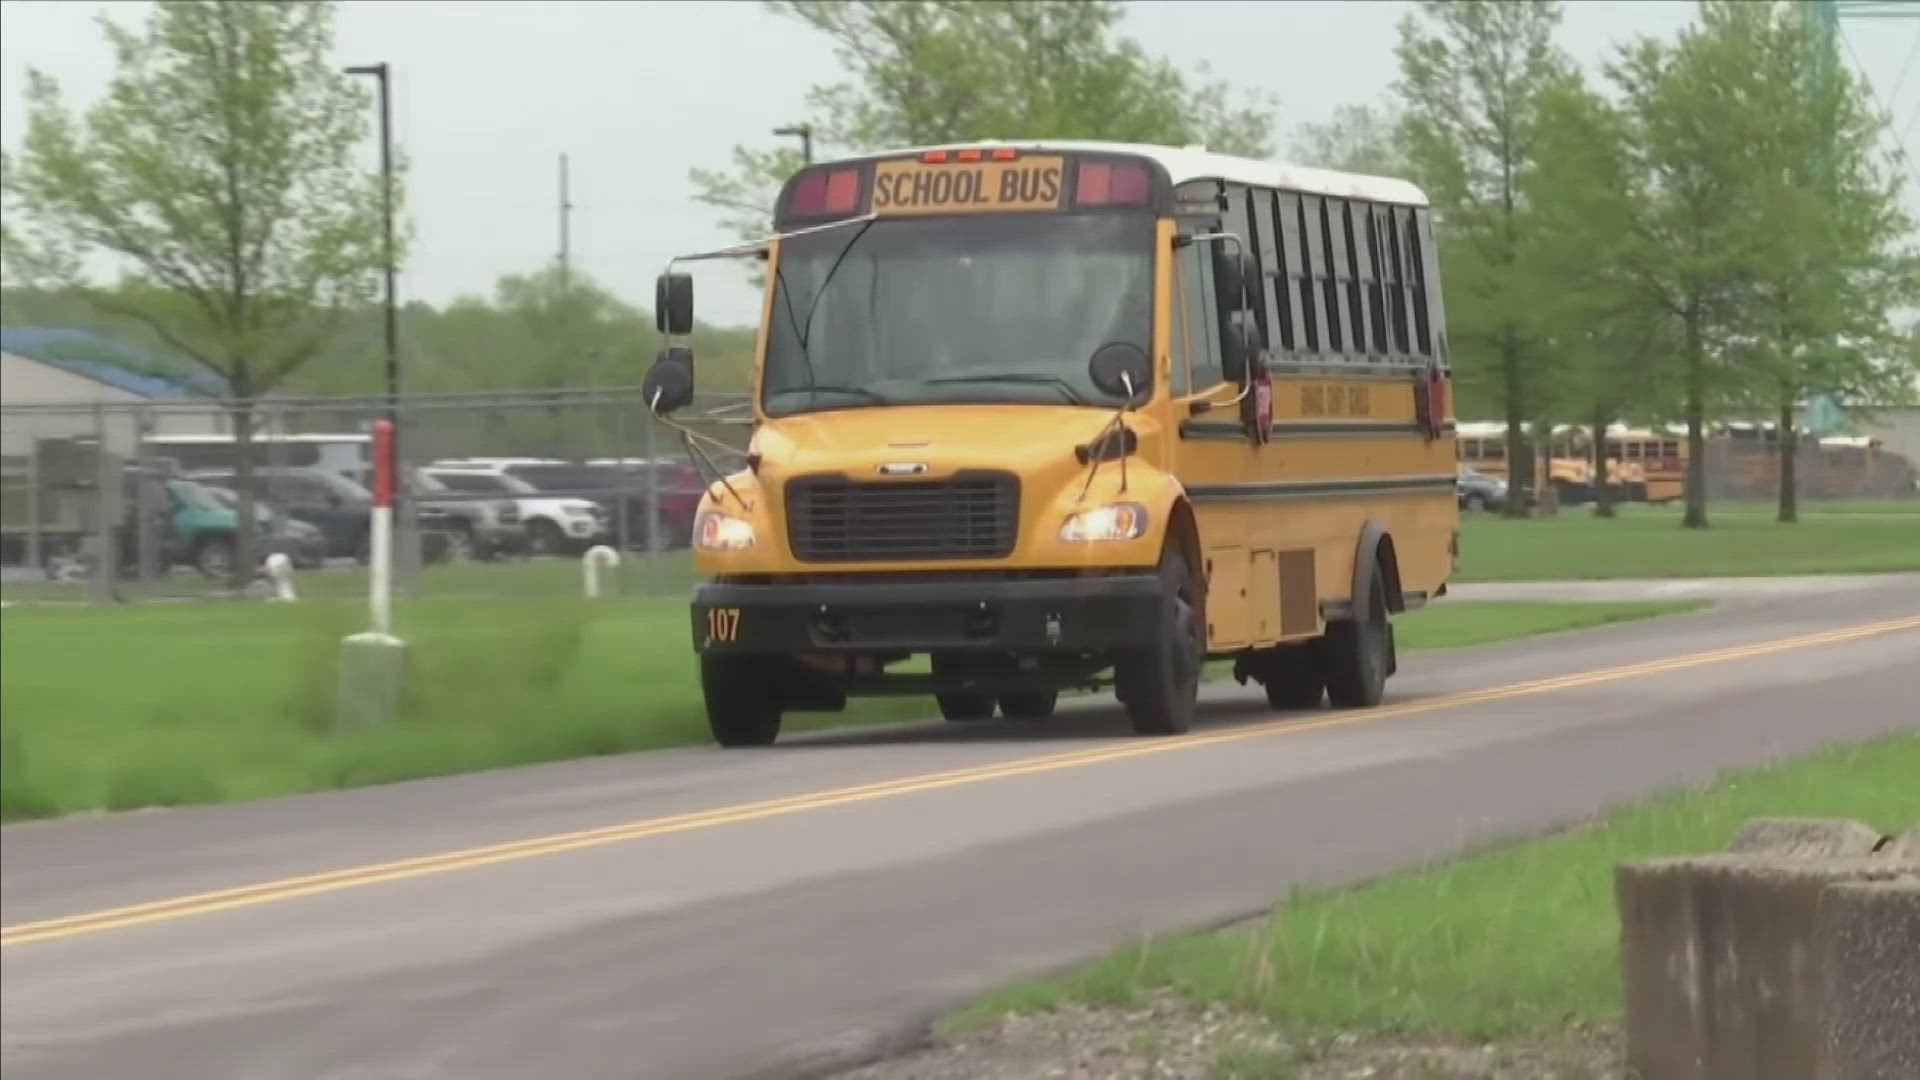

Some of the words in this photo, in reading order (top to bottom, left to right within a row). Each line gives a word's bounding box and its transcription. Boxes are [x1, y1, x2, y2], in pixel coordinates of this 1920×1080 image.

[874, 169, 989, 208] SCHOOL
[998, 166, 1061, 203] BUS
[707, 608, 741, 642] 107
